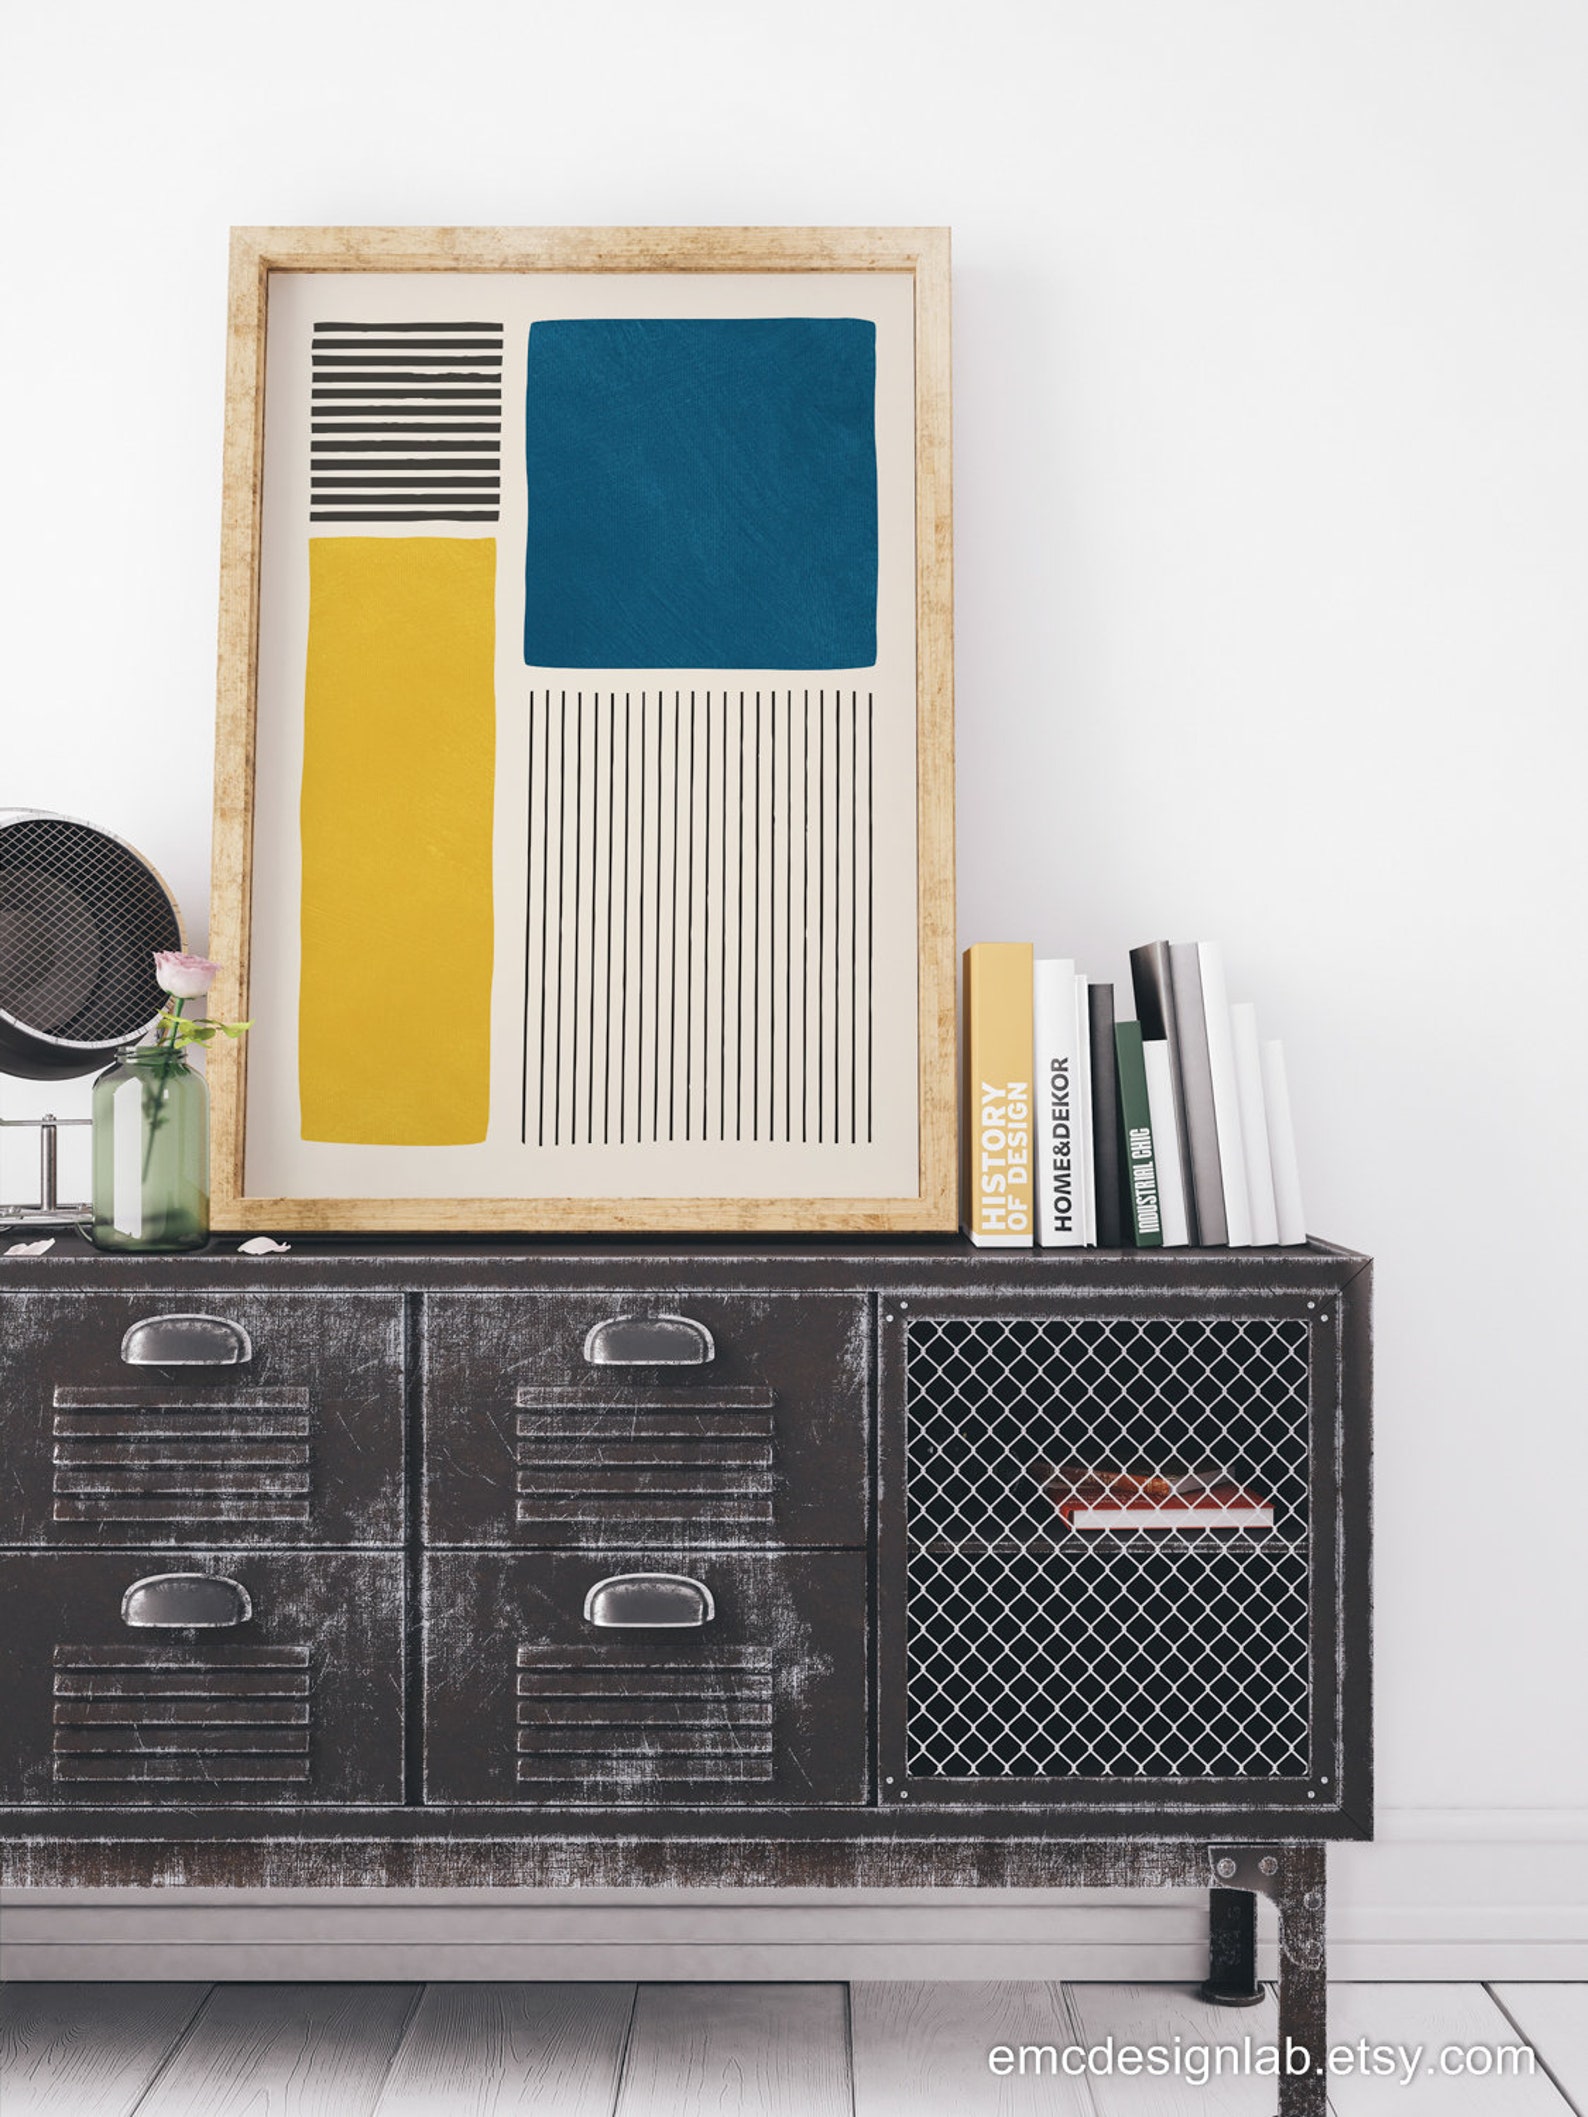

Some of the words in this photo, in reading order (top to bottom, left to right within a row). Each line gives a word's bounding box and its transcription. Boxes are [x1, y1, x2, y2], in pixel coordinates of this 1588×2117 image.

[981, 1082, 1006, 1230] HISTORY
[1007, 1082, 1028, 1184] DESIGN
[1051, 1057, 1072, 1232] HOME&DEKOR
[1129, 1127, 1152, 1160] CHIC
[1007, 1194, 1028, 1231] OF
[1132, 1161, 1160, 1234] INDUSTRIAL
